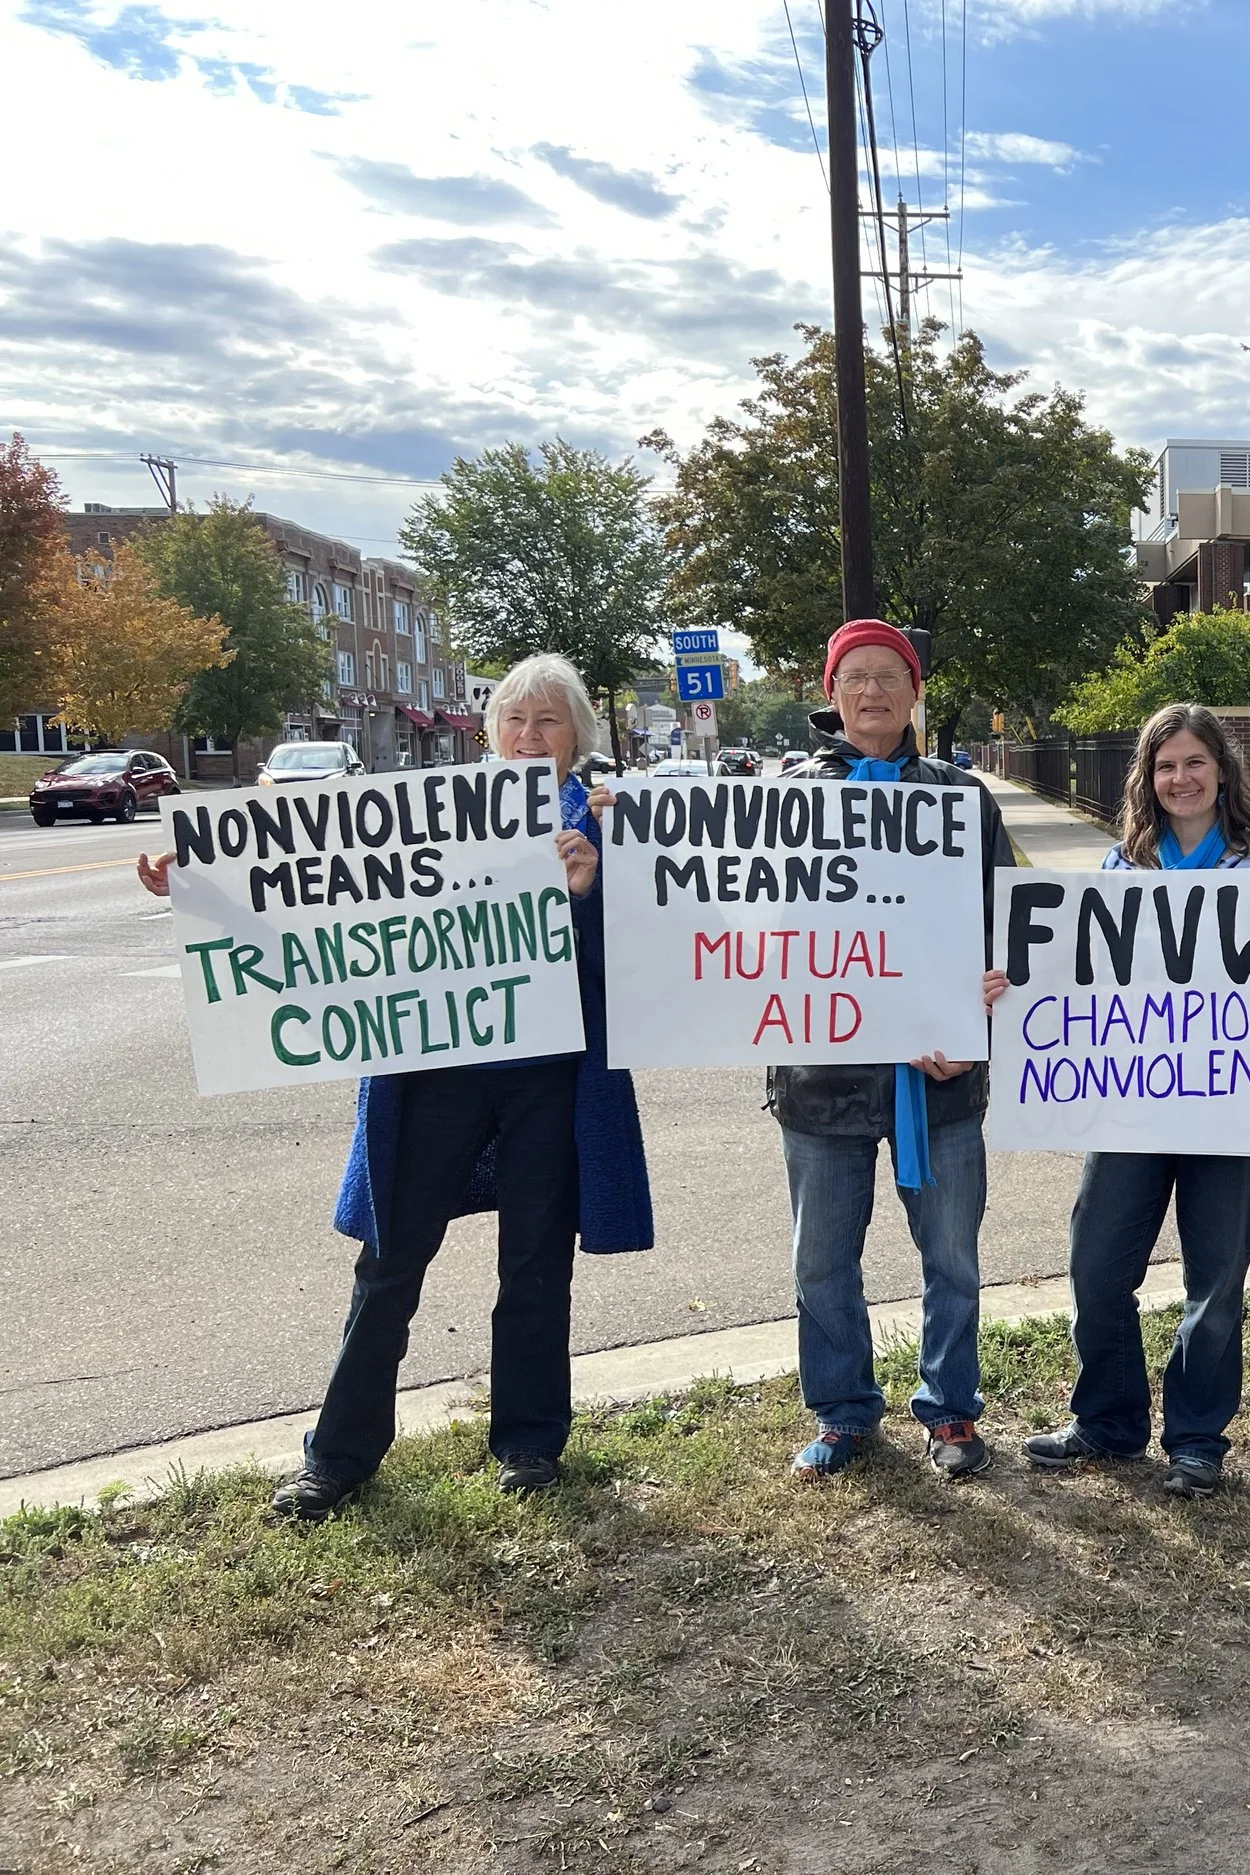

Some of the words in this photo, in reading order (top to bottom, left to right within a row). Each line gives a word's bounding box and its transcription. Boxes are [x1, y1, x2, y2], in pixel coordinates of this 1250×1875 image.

[675, 635, 717, 650] SOUTH
[684, 656, 720, 664] MINNESOTA
[687, 672, 713, 694] 51
[172, 766, 553, 867] NONVIOLENCE
[611, 783, 966, 858] NONVIOLENCE
[250, 848, 492, 912] MEANS...
[655, 856, 906, 906] MEANS...
[186, 888, 571, 1003] TRANSFORMING
[695, 931, 902, 980] MUTUAL
[272, 976, 530, 1065] CONFLICT
[753, 993, 861, 1045] AID
